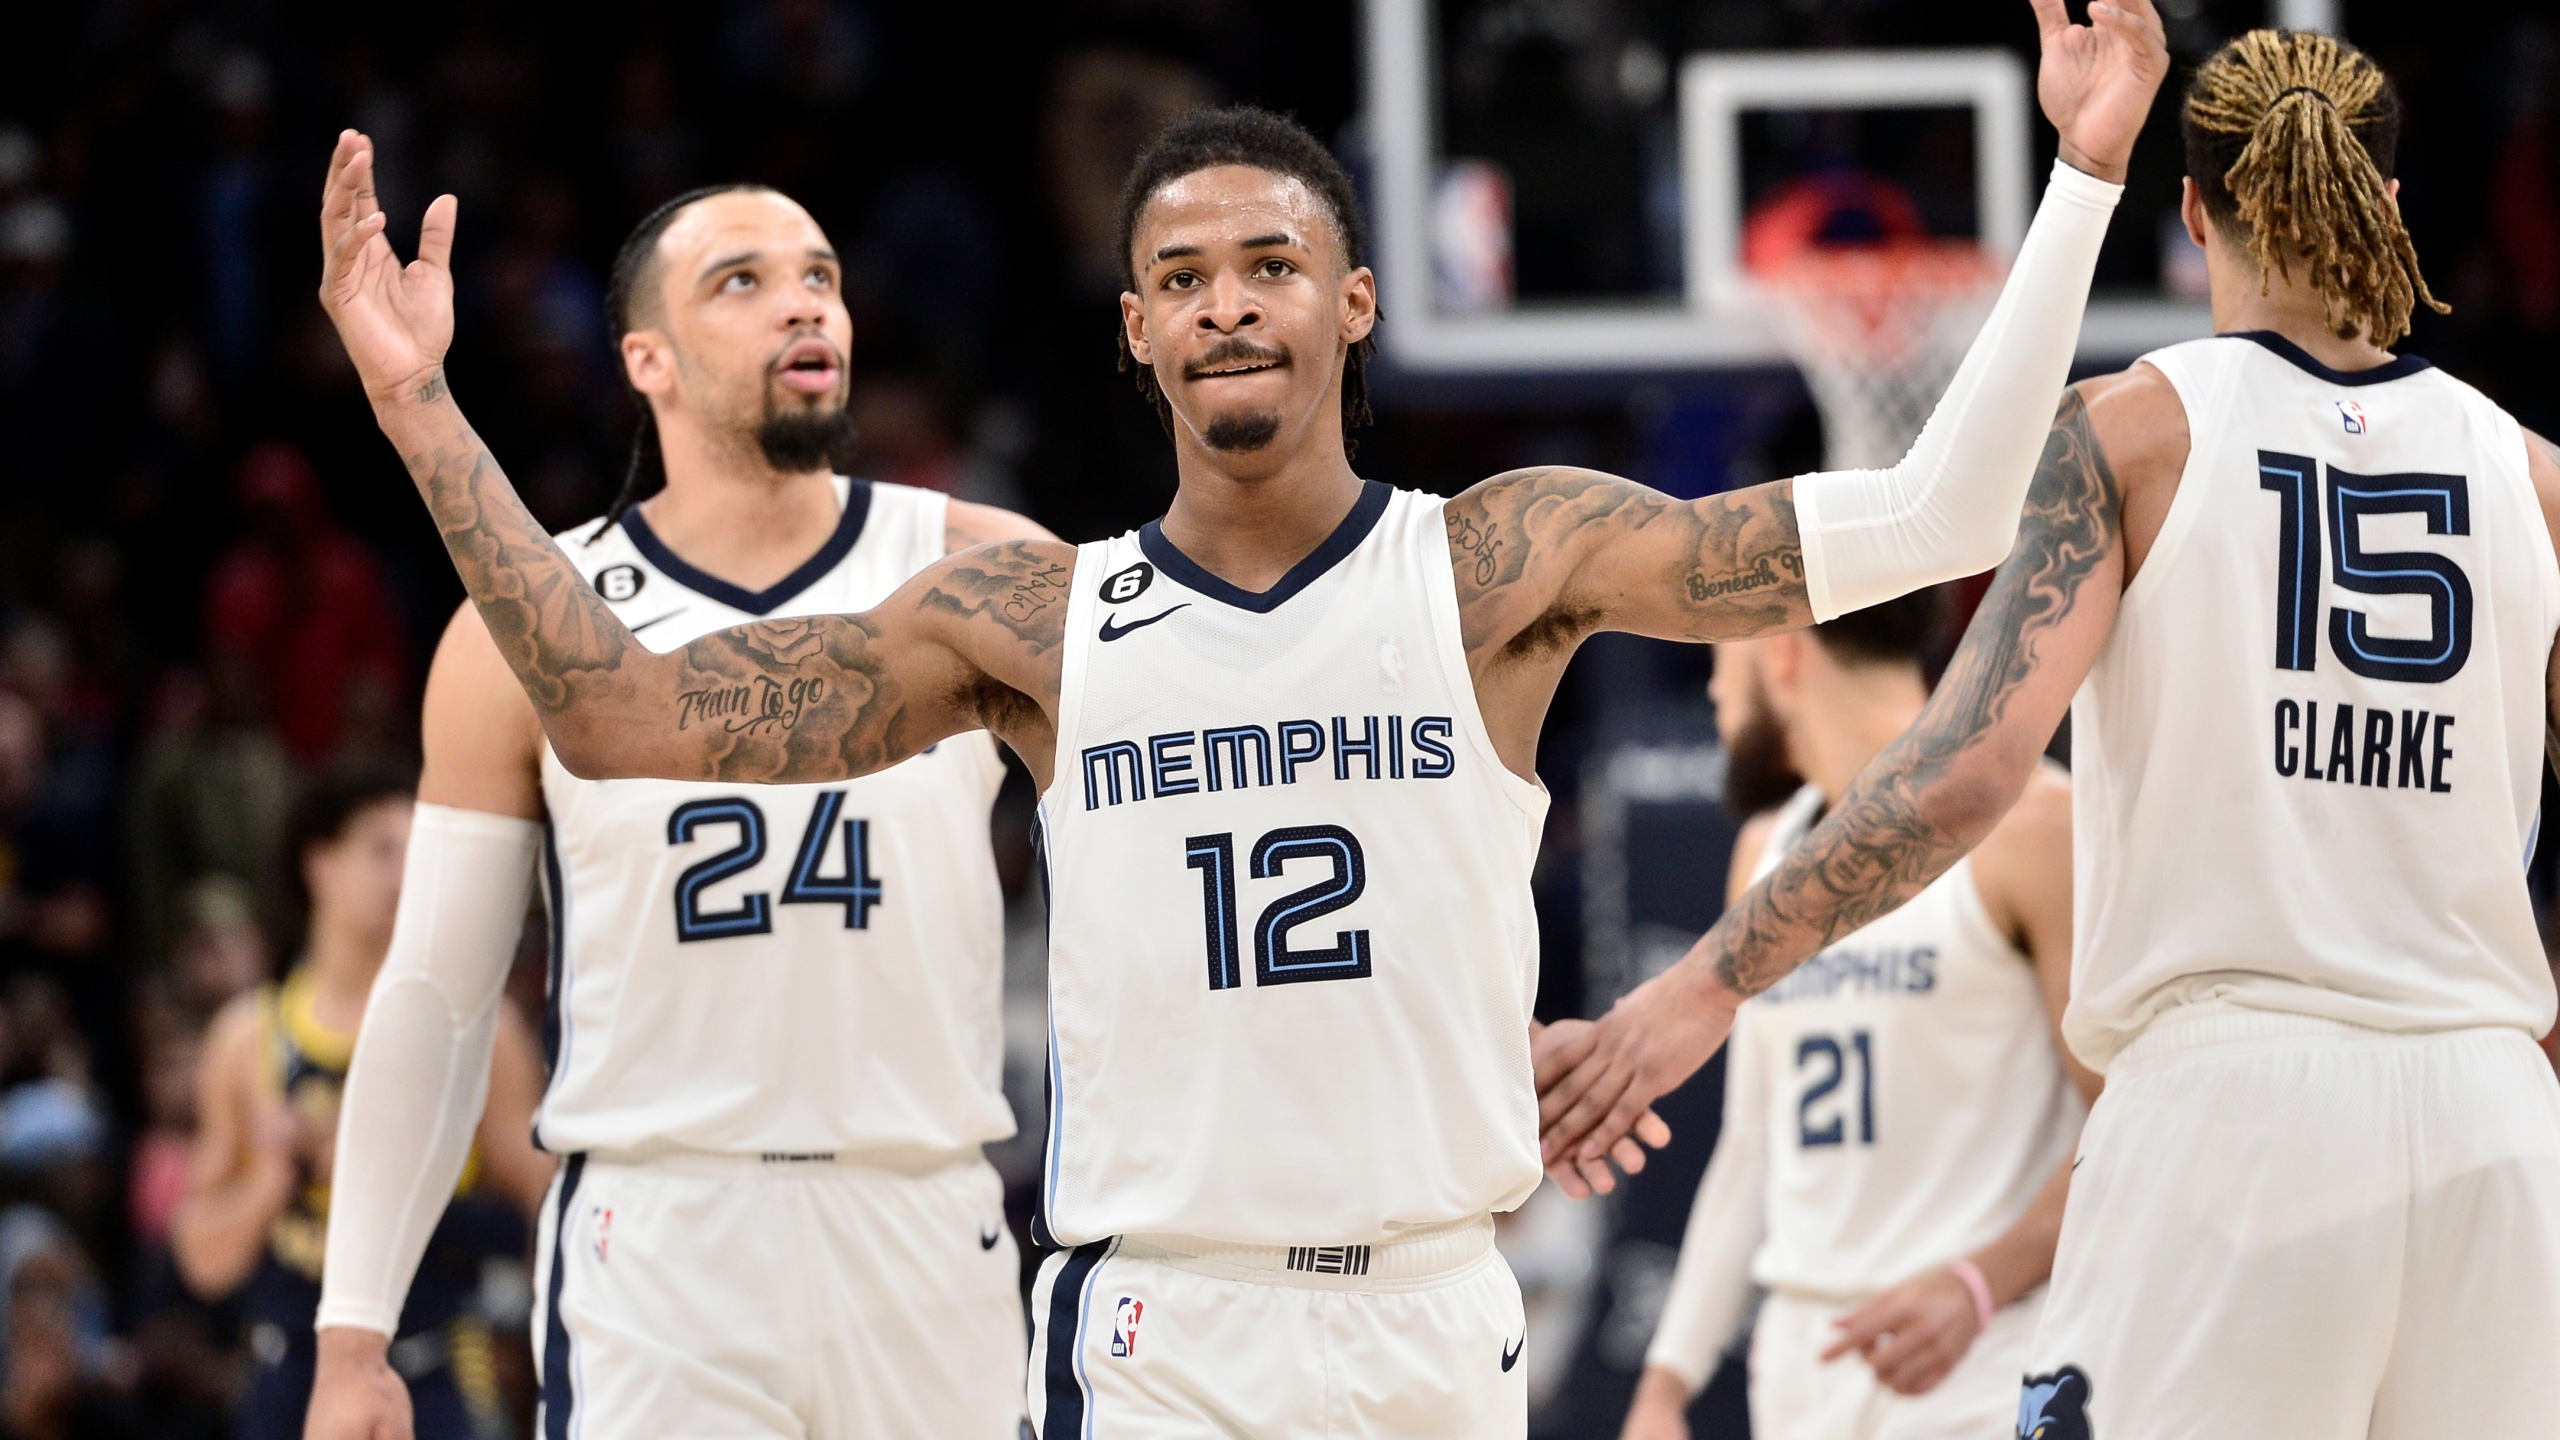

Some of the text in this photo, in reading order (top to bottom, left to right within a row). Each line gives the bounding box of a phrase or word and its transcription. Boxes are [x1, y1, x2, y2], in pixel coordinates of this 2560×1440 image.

[603, 566, 636, 600] 6
[1111, 569, 1143, 599] 6
[2257, 449, 2473, 684] 15
[676, 684, 751, 731] Train
[2274, 698, 2455, 793] CLARKE
[1081, 714, 1456, 811] MEMPHIS
[667, 790, 882, 943] 24
[1185, 823, 1373, 991] 12
[1797, 1030, 1874, 1147] 21
